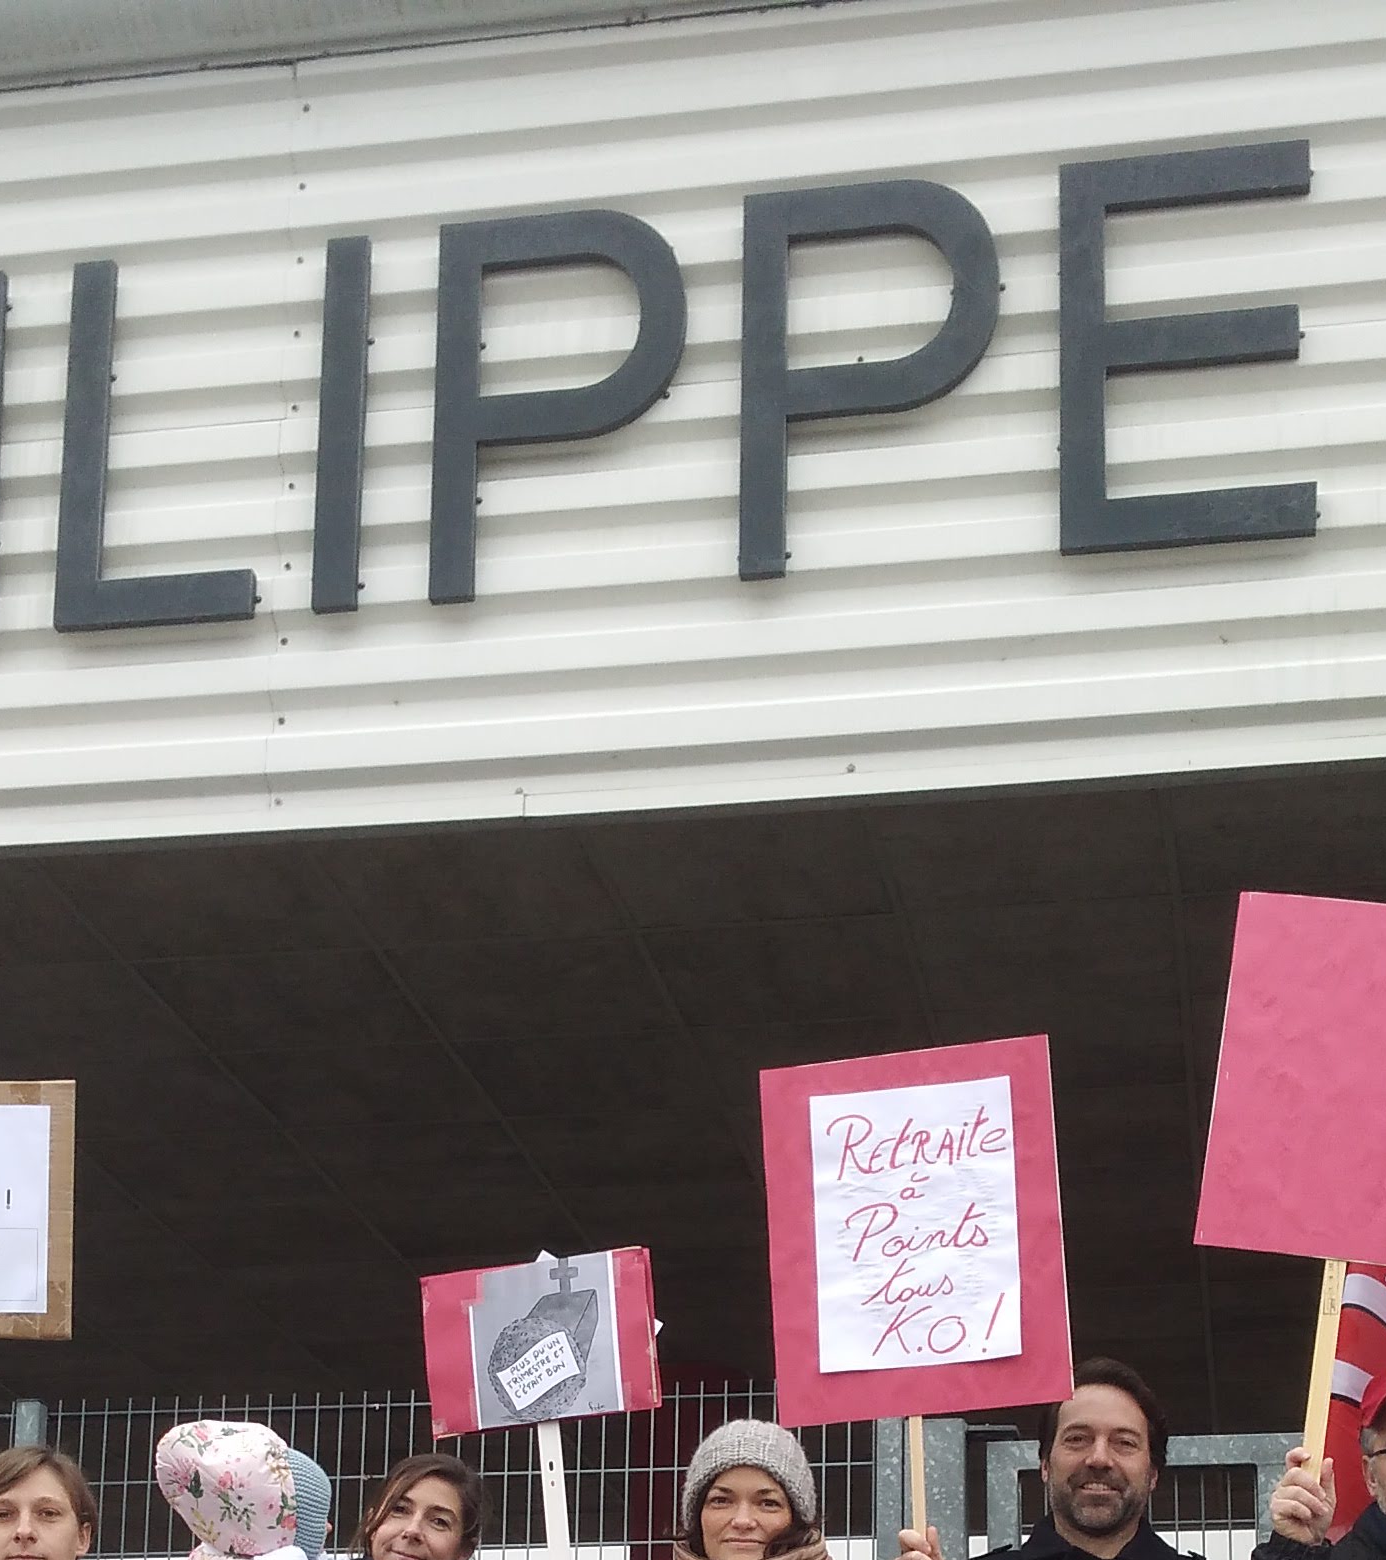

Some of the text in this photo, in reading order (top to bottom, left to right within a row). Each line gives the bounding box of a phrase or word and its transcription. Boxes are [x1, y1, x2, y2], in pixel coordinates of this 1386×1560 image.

[5, 1188, 13, 1211] !
[899, 1171, 930, 1201] à
[845, 1202, 989, 1263] Points
[860, 1257, 954, 1306] tous
